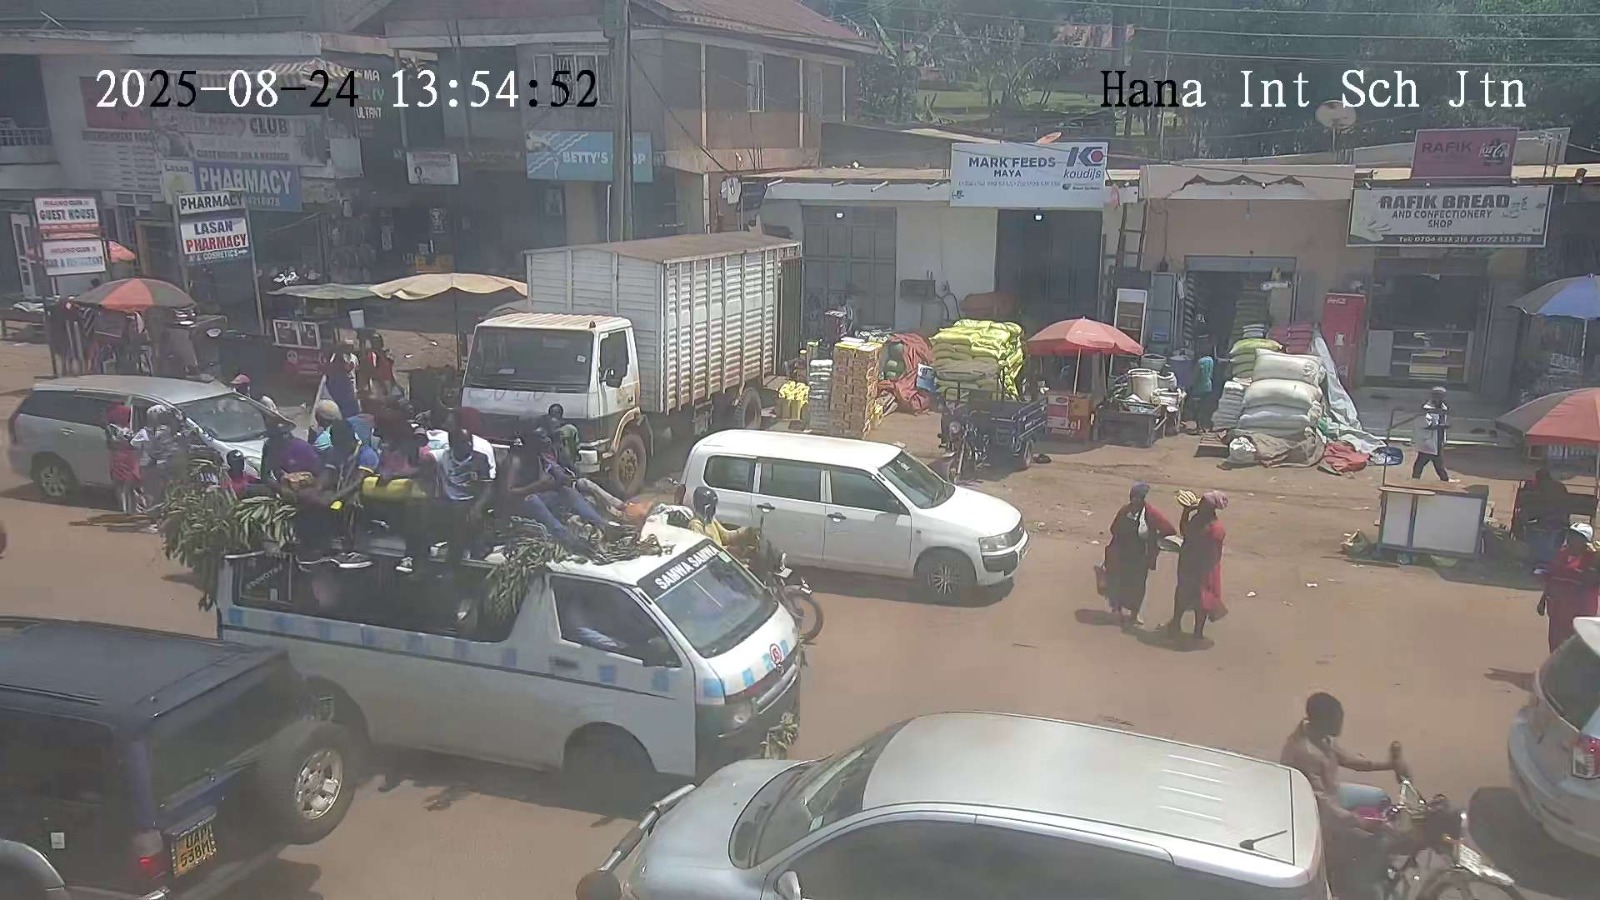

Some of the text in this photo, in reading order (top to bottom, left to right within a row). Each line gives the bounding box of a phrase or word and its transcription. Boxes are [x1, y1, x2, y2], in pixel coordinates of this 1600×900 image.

[355, 106, 382, 119] ULTANT
[249, 117, 289, 135] CLUB
[1421, 141, 1473, 153] RAFIK
[562, 152, 610, 166] BETTY'S
[968, 157, 1057, 168] MARK FEEDS
[993, 169, 1022, 178] MAYA
[199, 167, 292, 195] PHARMACY
[180, 192, 243, 210] PHARMACY
[1379, 193, 1510, 209] RAFIK BREAD
[40, 208, 96, 220] GUEST HOUSE
[1392, 210, 1493, 219] AND CONFECTIONERY
[194, 221, 233, 235] LASAN
[1428, 219, 1453, 228] SHOP
[186, 234, 247, 252] PHARMACY
